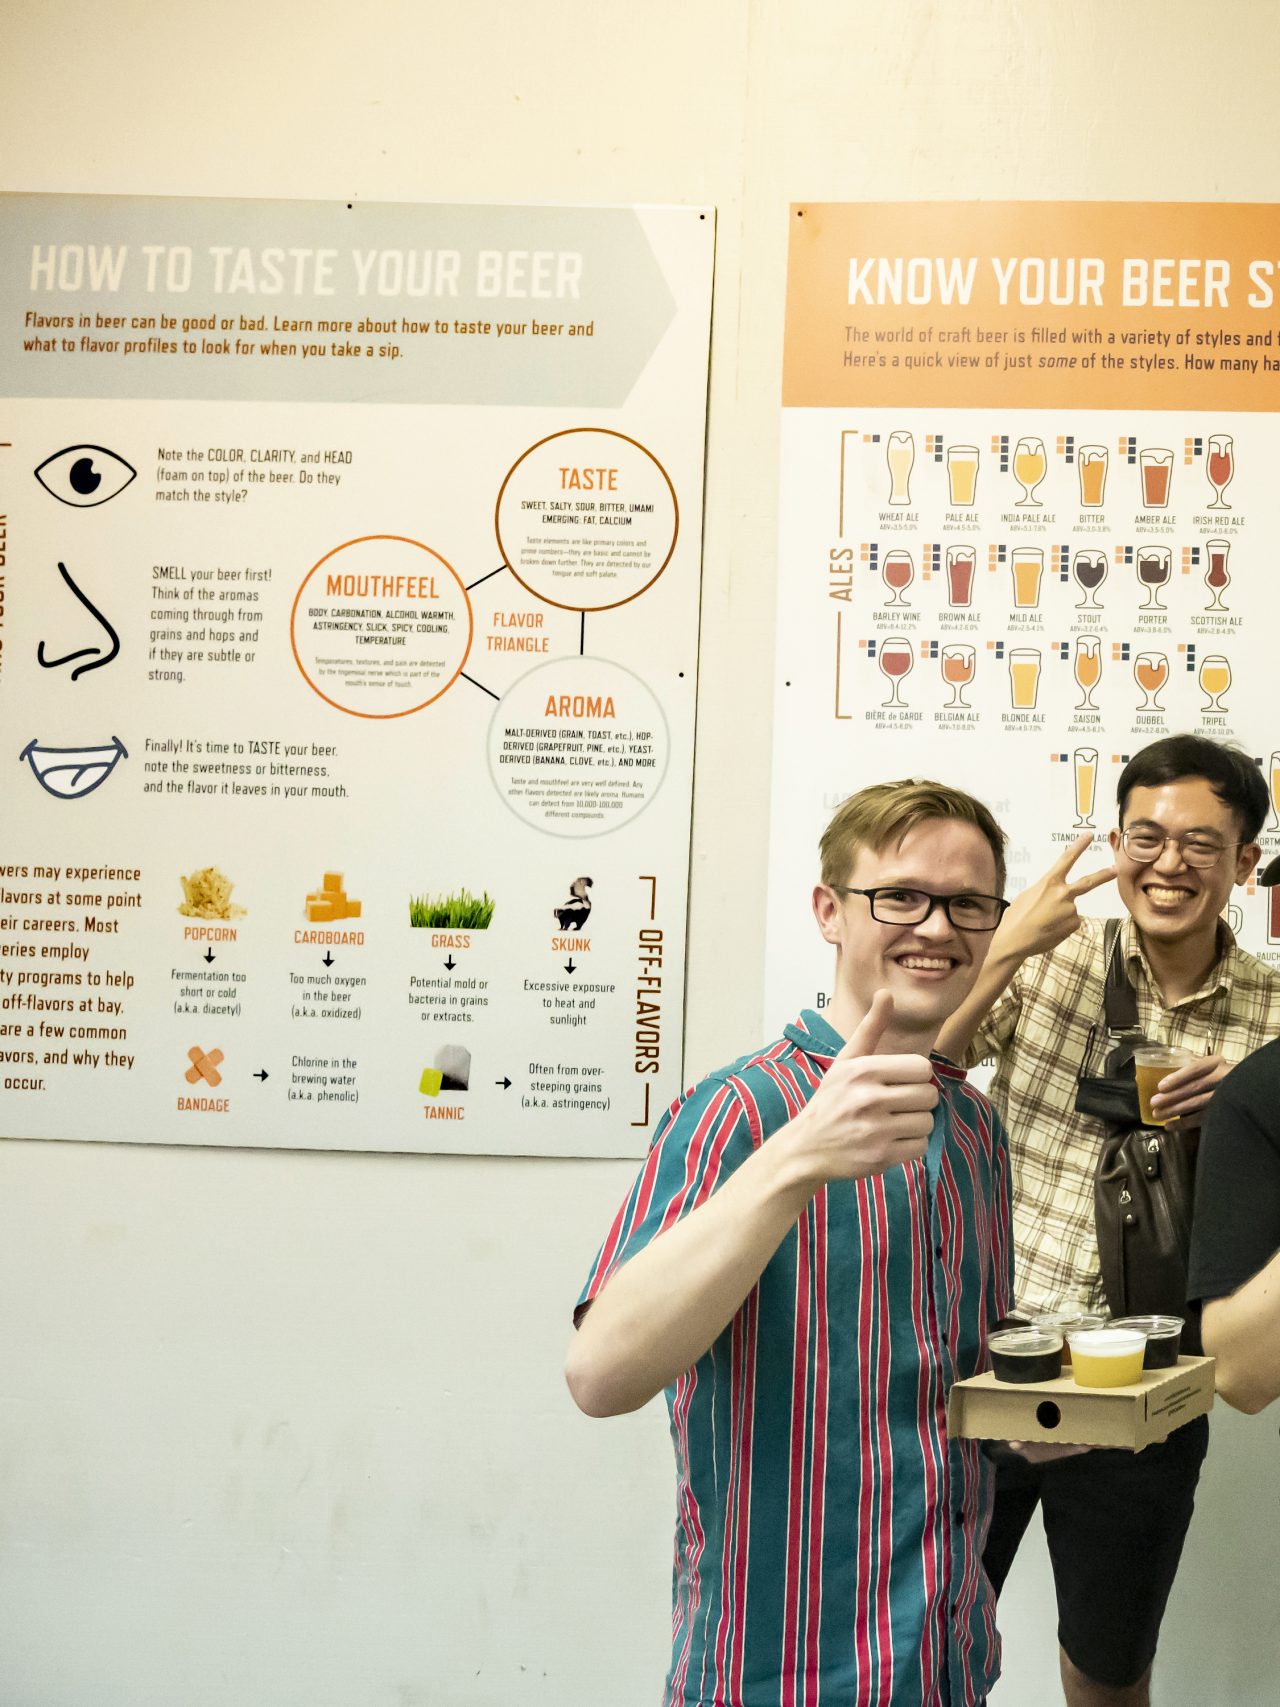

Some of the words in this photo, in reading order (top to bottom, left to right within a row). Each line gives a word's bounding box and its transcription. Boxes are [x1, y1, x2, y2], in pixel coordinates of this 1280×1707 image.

[29, 244, 126, 292] HOW
[143, 245, 191, 293] TO
[210, 246, 337, 294] TASTE
[353, 249, 461, 296] YOUR
[477, 250, 584, 299] BEER
[848, 257, 978, 305] KNOW
[992, 258, 1105, 307] YOUR
[1124, 259, 1229, 307] BEER
[24, 310, 75, 328] Flavors
[78, 312, 91, 328] in
[95, 312, 127, 329] beer
[131, 317, 156, 329] can
[160, 313, 177, 330] be
[181, 314, 216, 333] good
[220, 318, 235, 330] or
[239, 314, 268, 331] bad.
[273, 315, 313, 332] Learn
[317, 320, 353, 332] more
[357, 317, 397, 333] about
[401, 317, 430, 334] how
[434, 319, 449, 334] to
[454, 320, 491, 334] taste
[496, 323, 530, 337] your
[532, 319, 564, 336] beer
[568, 320, 594, 336] and
[845, 326, 869, 343] The
[875, 327, 913, 343] world
[919, 327, 933, 343] of
[938, 327, 971, 343] craft
[976, 327, 1008, 343] beer
[1014, 328, 1025, 343] is
[1031, 328, 1066, 344] filled
[1072, 328, 1102, 344] with
[1108, 333, 1115, 344] a
[1121, 329, 1171, 348] variety
[1176, 329, 1191, 345] of
[1196, 329, 1241, 348] styles
[1246, 330, 1272, 346] and
[157, 447, 183, 461] Note
[186, 448, 204, 462] the
[207, 448, 245, 462] COLOR,
[250, 448, 296, 463] CLARITY,
[300, 451, 321, 464] and
[324, 450, 353, 464] HEAD
[559, 467, 618, 491] TASTE
[878, 512, 904, 521] WHEAT
[906, 512, 919, 522] ALE
[945, 512, 963, 522] PALE
[965, 513, 979, 522] ALE
[1001, 513, 1021, 523] INDIA
[1022, 513, 1040, 523] PALE
[1042, 514, 1056, 523] ALE
[1079, 514, 1105, 523] BITTER
[1134, 515, 1161, 524] AMBER
[1162, 515, 1176, 525] ALE
[1193, 515, 1213, 525] IRISH
[1214, 516, 1230, 526] RED
[1231, 517, 1245, 526] ALE
[152, 565, 187, 580] SMELL
[190, 570, 214, 582] your
[217, 567, 242, 581] beer
[245, 567, 272, 581] first!
[829, 548, 853, 602] ALES
[326, 574, 440, 599] MOUTHFEEL
[493, 612, 544, 628] FLAVOR
[872, 611, 901, 621] BARLEY
[902, 612, 920, 621] WINE
[938, 612, 966, 622] BROWN
[967, 612, 980, 622] ALE
[1138, 615, 1168, 624] PORTER
[1191, 616, 1227, 625] SCOTTISH
[1230, 617, 1243, 626] ALE
[486, 635, 549, 653] TRIANGLE
[544, 695, 615, 718] AROMA
[1073, 714, 1101, 724] SAISON
[1136, 715, 1165, 725] DUBBEL
[1202, 716, 1226, 726] TRIPEL
[184, 927, 238, 942] POPCORN
[294, 930, 365, 945] CARDBOARD
[431, 935, 471, 949] GRASS
[551, 937, 591, 951] SKUNK
[523, 978, 570, 992] Excessive
[572, 983, 616, 994] exposure
[542, 997, 552, 1008] to
[554, 996, 575, 1009] heat
[578, 997, 596, 1009] and
[635, 929, 663, 1074] OFF-FLAVORS
[550, 1013, 587, 1027] sunlight
[178, 1097, 231, 1112] BANDAGE
[424, 1105, 465, 1120] TANNIC
